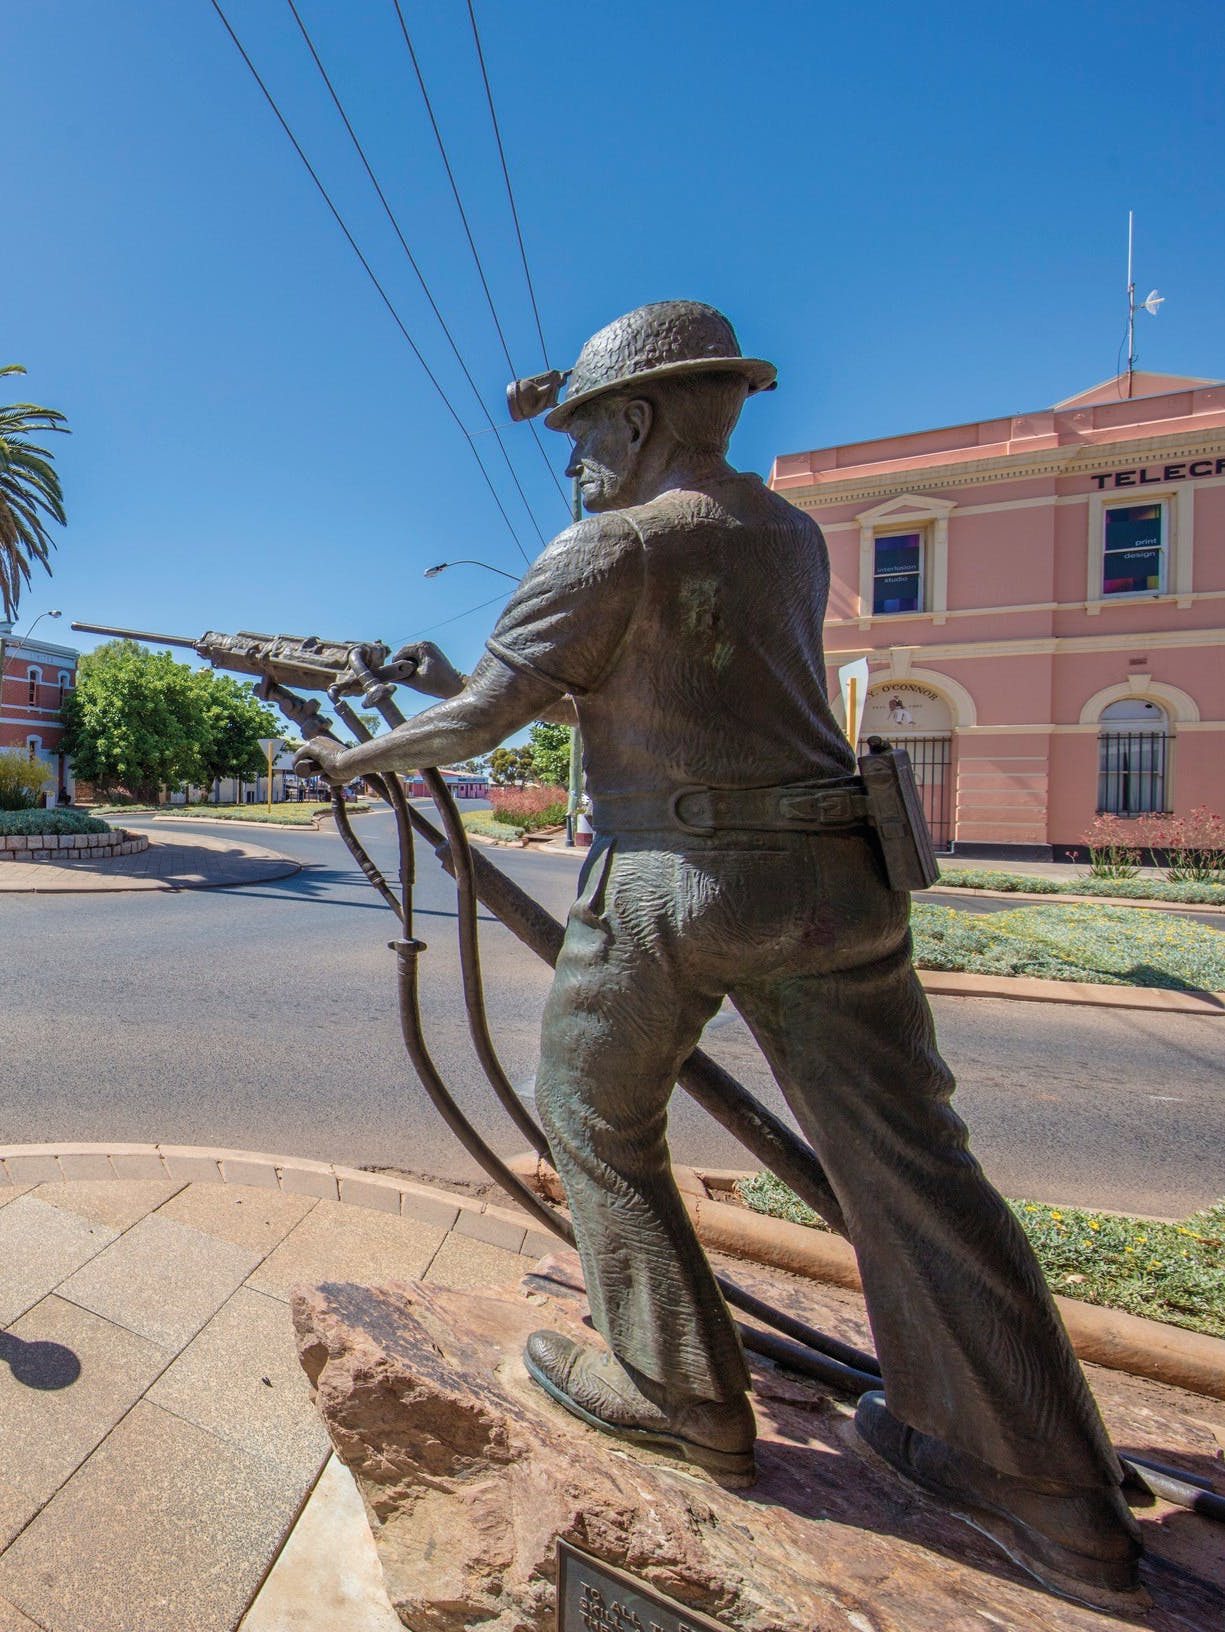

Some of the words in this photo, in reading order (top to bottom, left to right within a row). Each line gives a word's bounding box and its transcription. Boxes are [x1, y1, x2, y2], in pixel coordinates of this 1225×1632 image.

[1136, 538, 1157, 546] print
[1124, 551, 1156, 559] design
[882, 683, 938, 701] O'CONNOR
[580, 1581, 601, 1600] TO
[610, 1601, 641, 1625] ALL
[580, 1597, 624, 1630] SKILL
